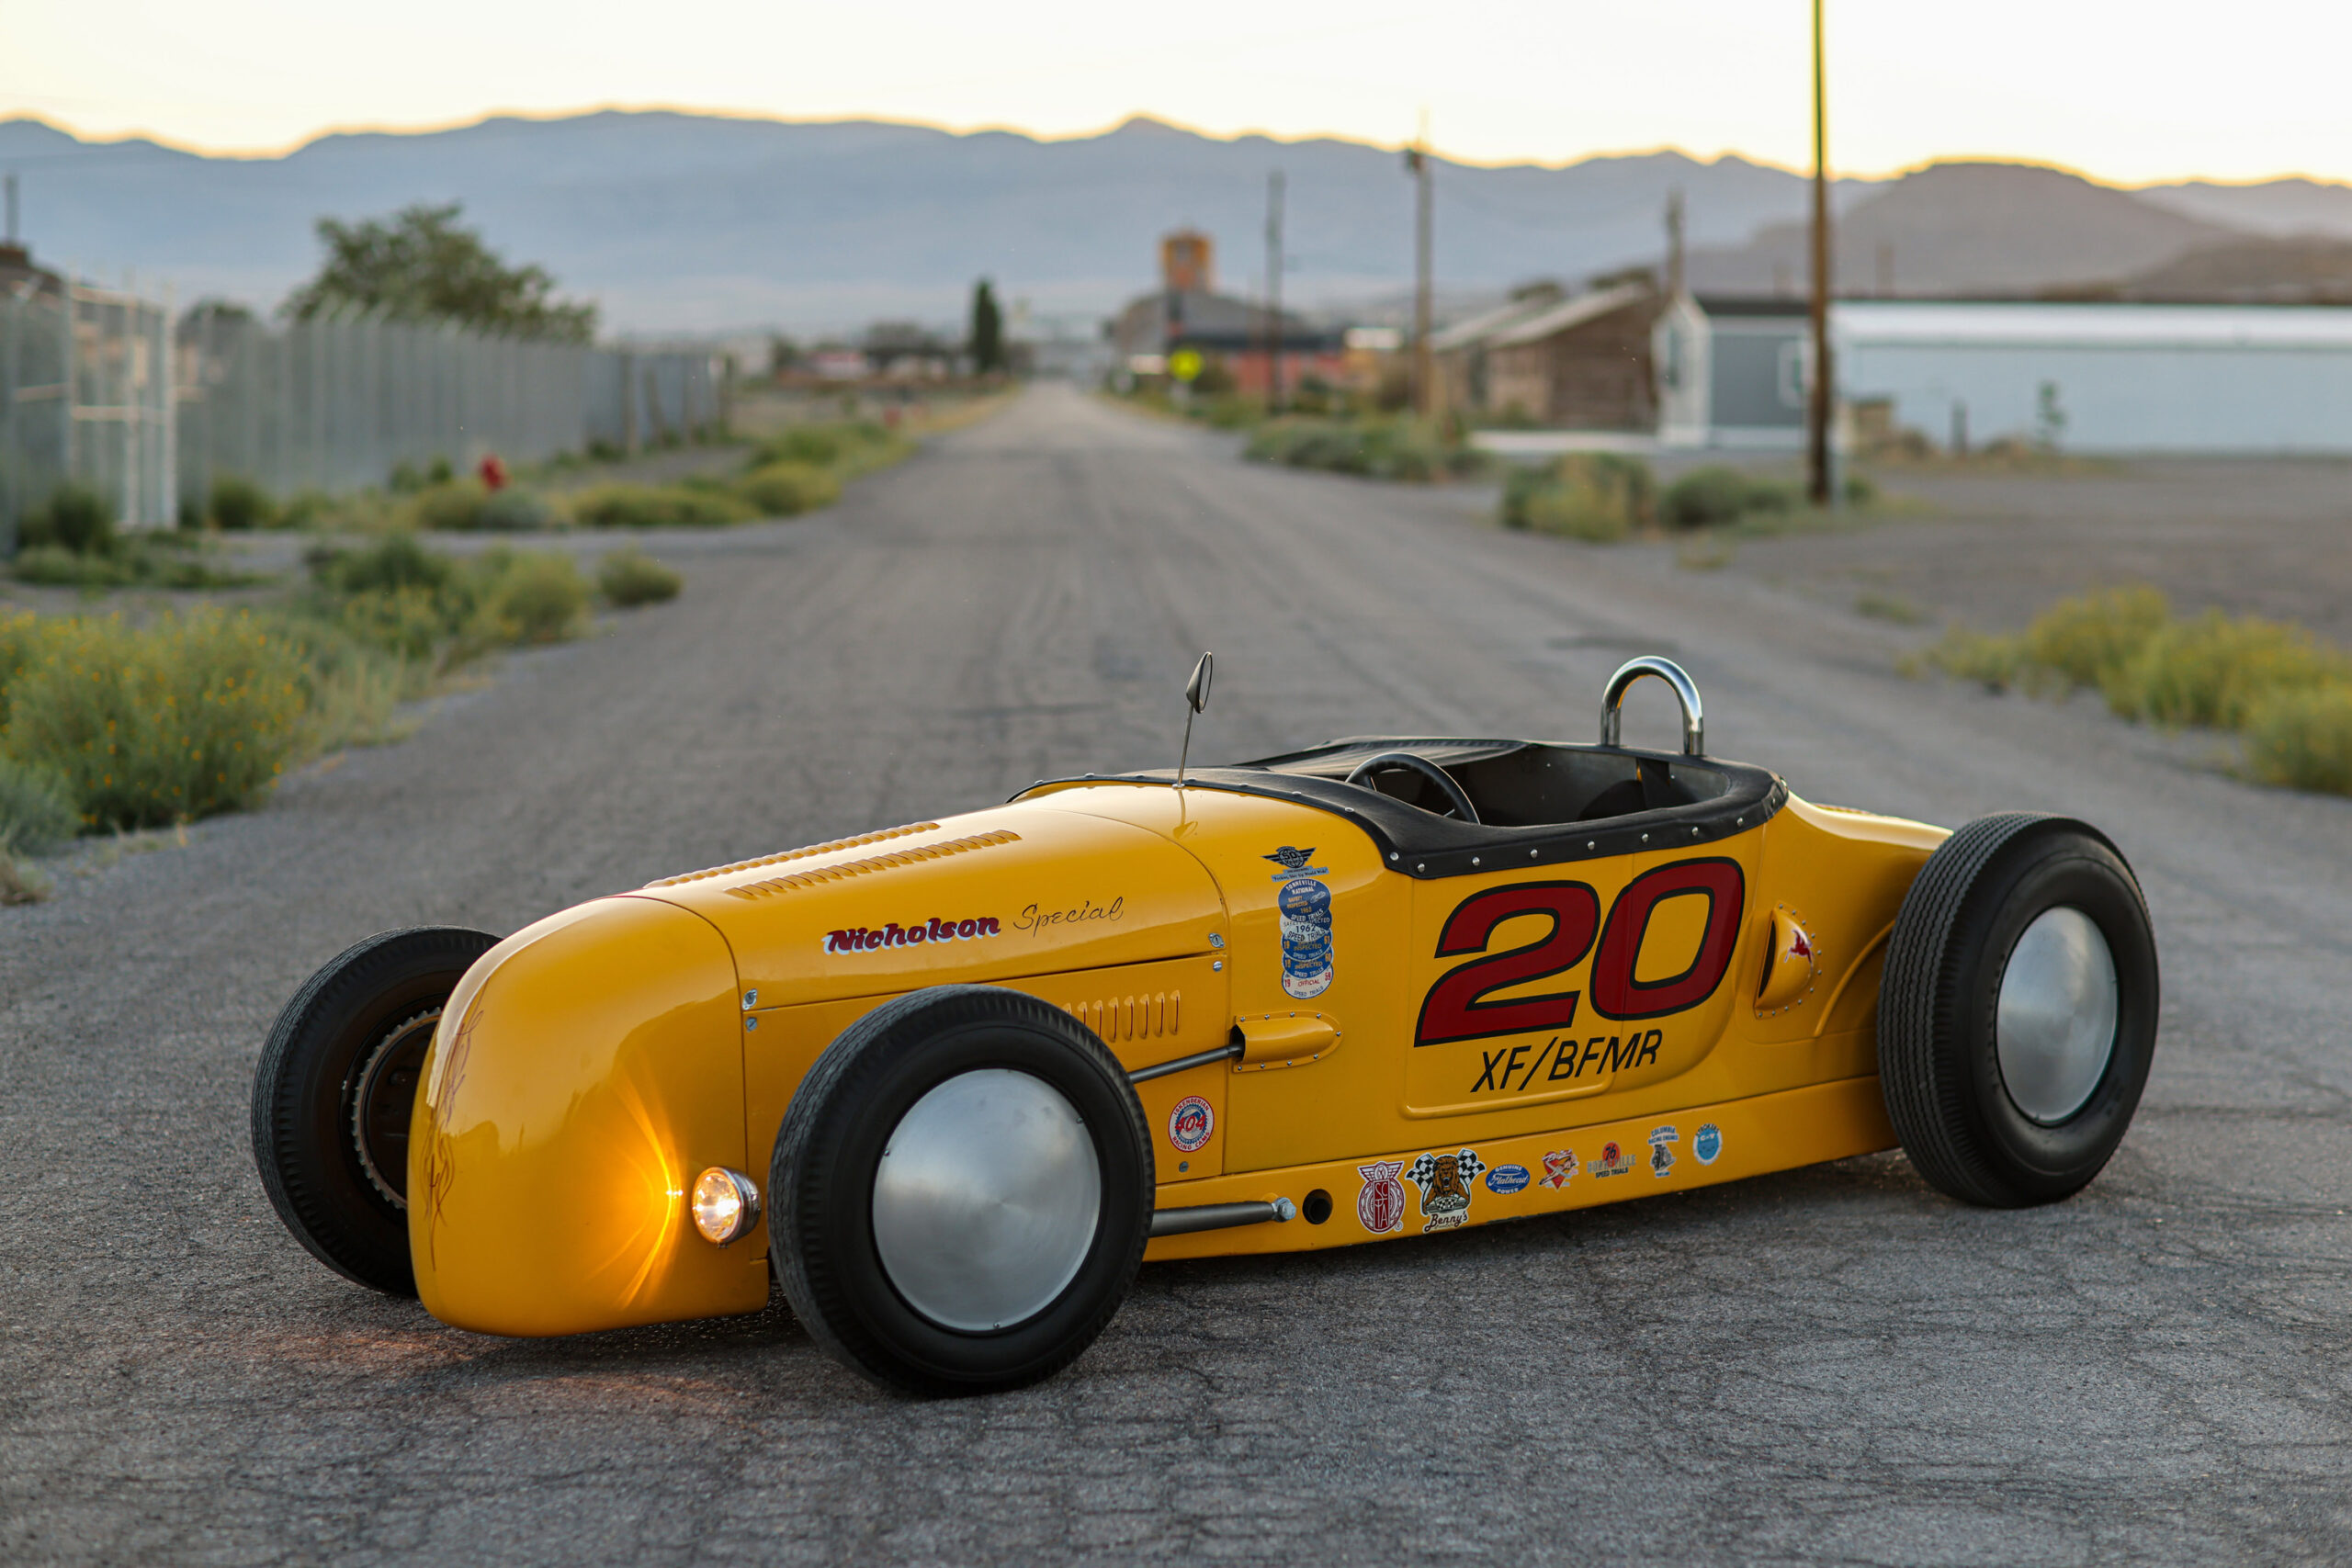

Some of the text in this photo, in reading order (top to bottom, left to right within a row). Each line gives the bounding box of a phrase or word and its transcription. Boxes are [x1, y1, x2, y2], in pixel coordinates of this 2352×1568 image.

[1286, 880, 1317, 891] BONNEVILLE
[1292, 886, 1315, 895] NATIONAL
[1291, 908, 1324, 921] SPEED TRIALS
[822, 897, 1124, 955] Nicholson Special
[1296, 925, 1316, 933] 1962
[1287, 928, 1326, 942] SPEED TRIALS
[1414, 856, 1746, 1048] 20
[1295, 961, 1323, 969] INSPECTED
[1309, 966, 1324, 976] TRIALS
[1284, 972, 1331, 987] 19 OFFICIAL 59
[1309, 986, 1324, 995] TRIALS
[1470, 1029, 1663, 1093] XF/BFMR
[1175, 1114, 1206, 1132] 404
[1172, 1132, 1210, 1150] RACING CAMS
[1606, 1144, 1617, 1161] 76
[1487, 1171, 1529, 1186] Flathead
[1595, 1167, 1629, 1179] SPEED TRIALS
[1424, 1210, 1468, 1232] Benny's
